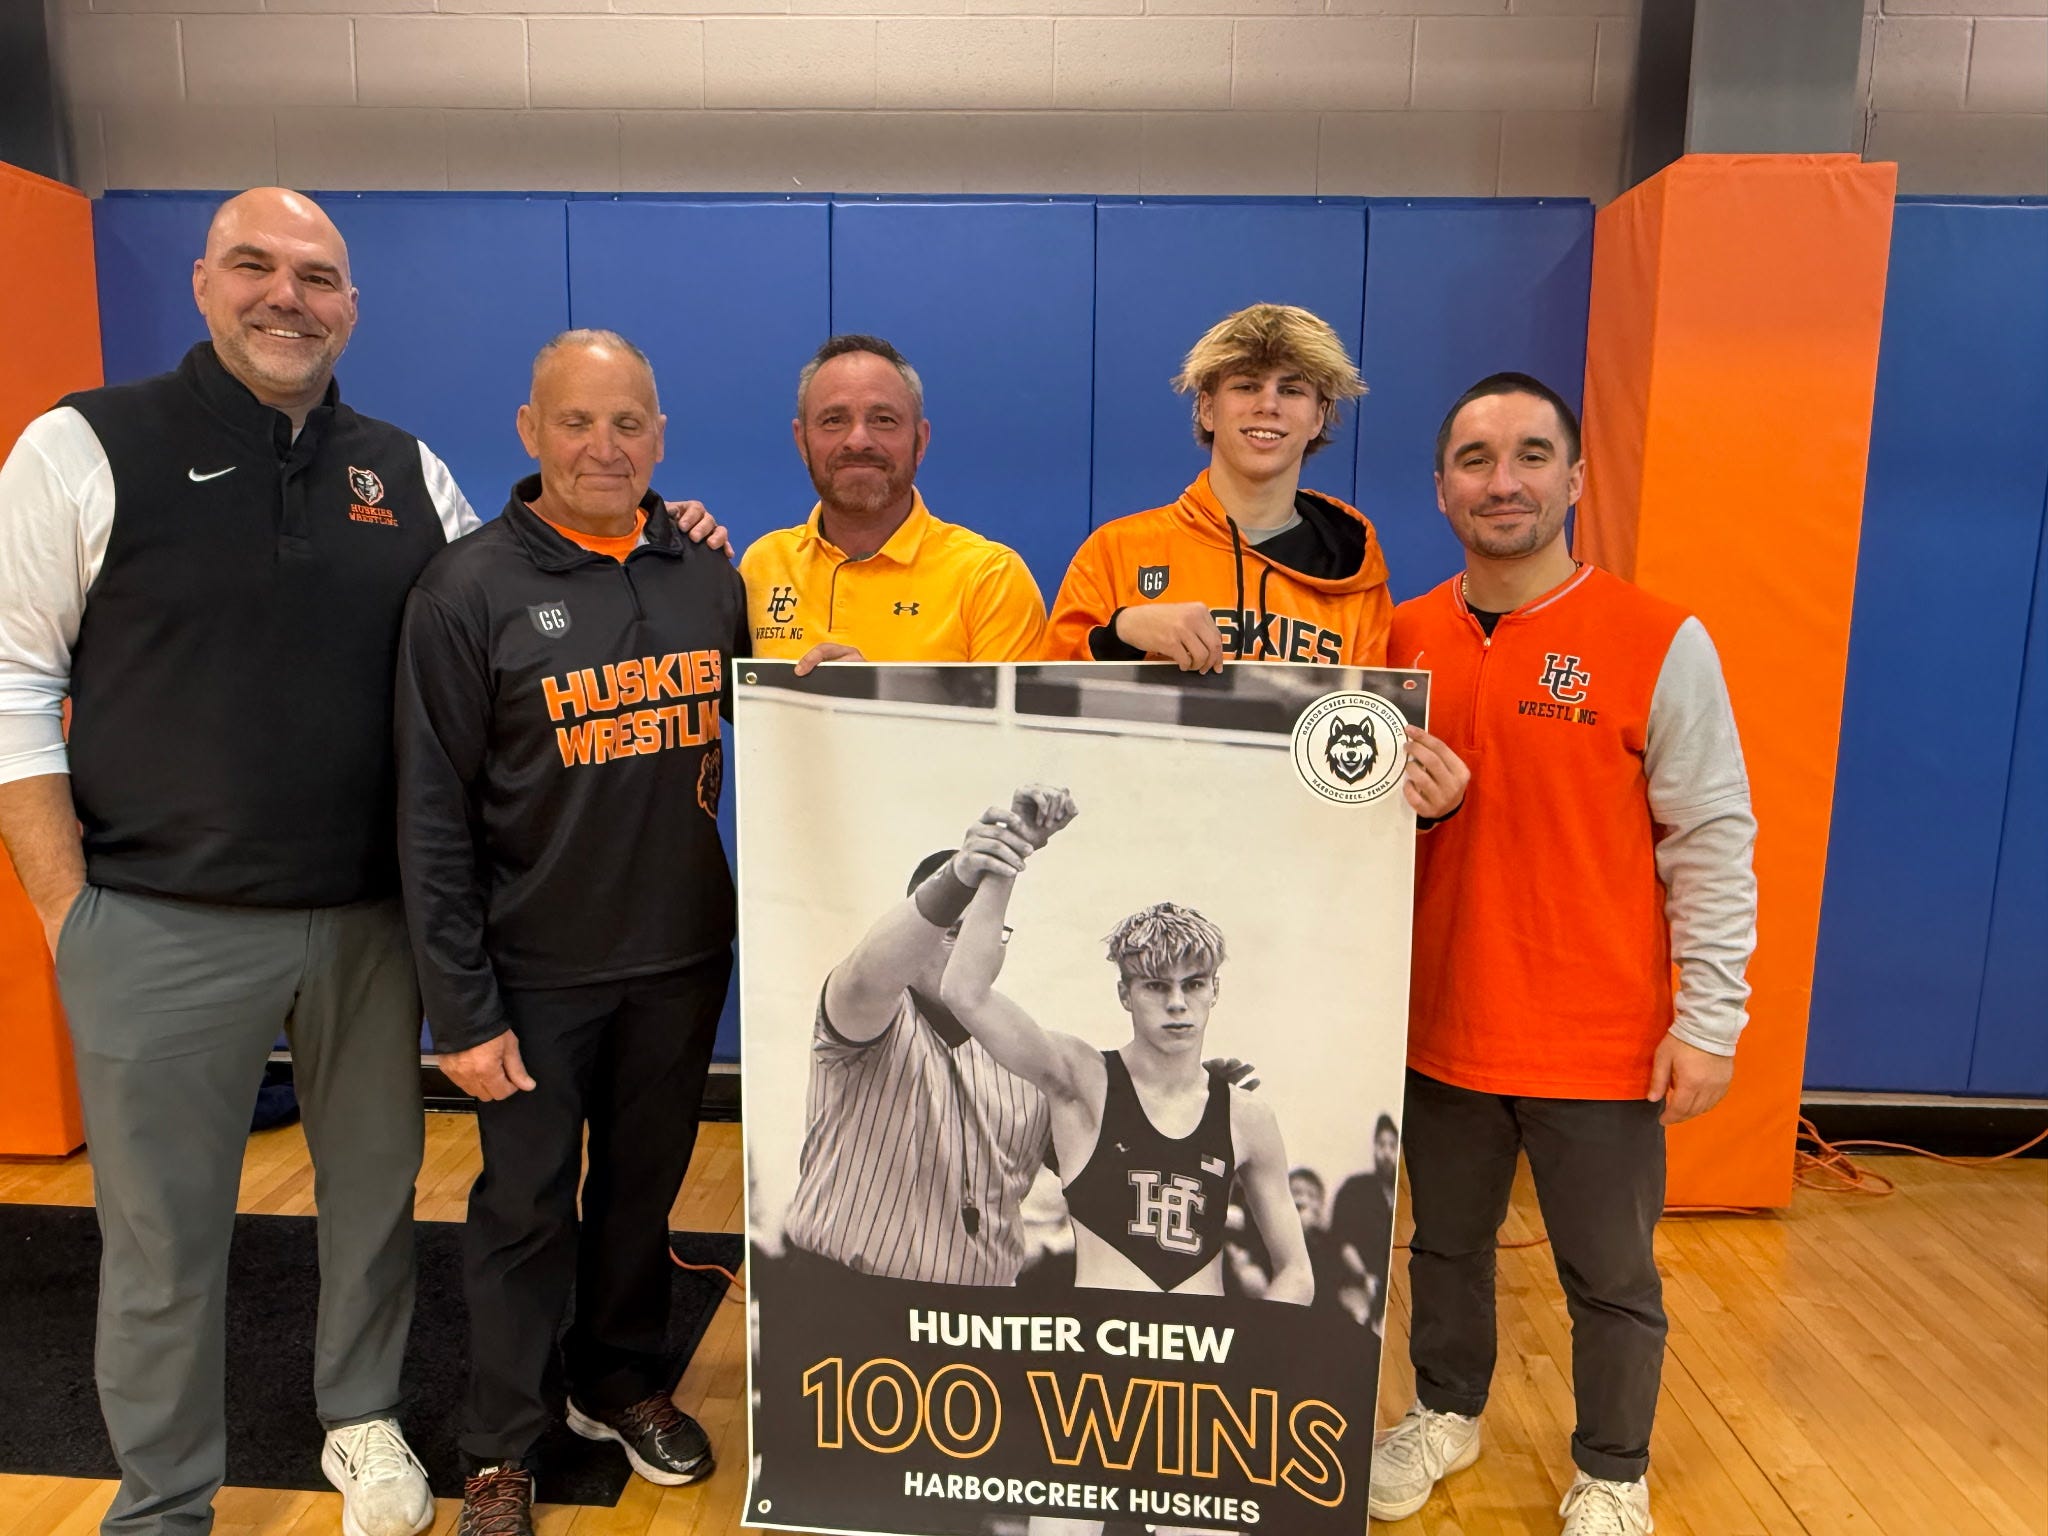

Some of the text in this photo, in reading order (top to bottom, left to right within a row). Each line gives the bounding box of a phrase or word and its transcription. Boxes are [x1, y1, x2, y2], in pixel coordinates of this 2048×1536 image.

[767, 587, 797, 623] HC
[756, 626, 804, 640] WRESTLNG
[1210, 608, 1343, 665] SKIES
[541, 650, 721, 721] HUSKIES
[1538, 652, 1591, 704] HC
[1518, 700, 1598, 726] WRESTLING
[1128, 1169, 1207, 1256] HC
[909, 1309, 1235, 1364] HUNTER CHEW
[803, 1357, 1348, 1508] 100 WINS
[904, 1471, 1261, 1524] HARBORCREEK HUSKIES
